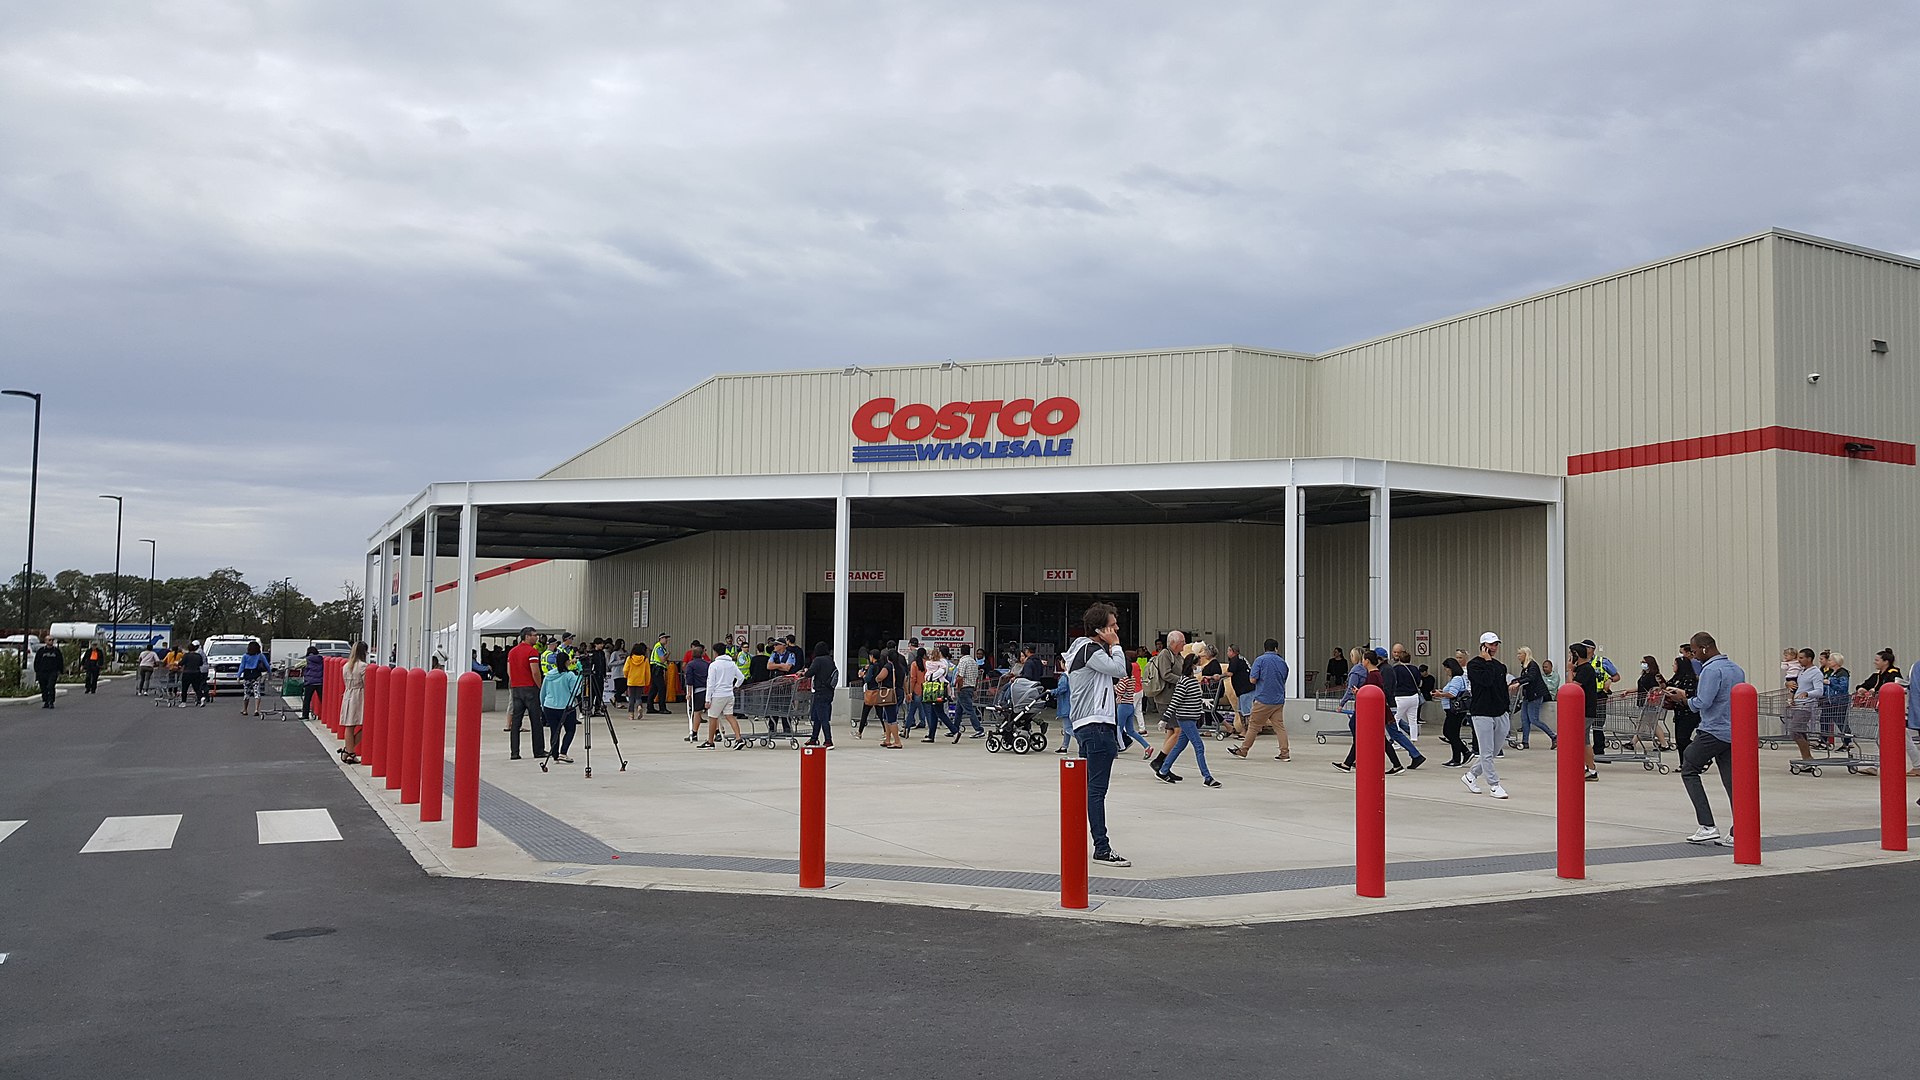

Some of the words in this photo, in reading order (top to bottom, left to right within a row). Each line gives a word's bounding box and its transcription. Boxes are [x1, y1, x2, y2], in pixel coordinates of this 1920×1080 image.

[852, 397, 1080, 442] COSTCO
[915, 439, 1074, 461] WHOLESALE
[825, 571, 884, 580] ERANCE
[1046, 570, 1074, 579] EXIT
[921, 628, 965, 637] COSTCO
